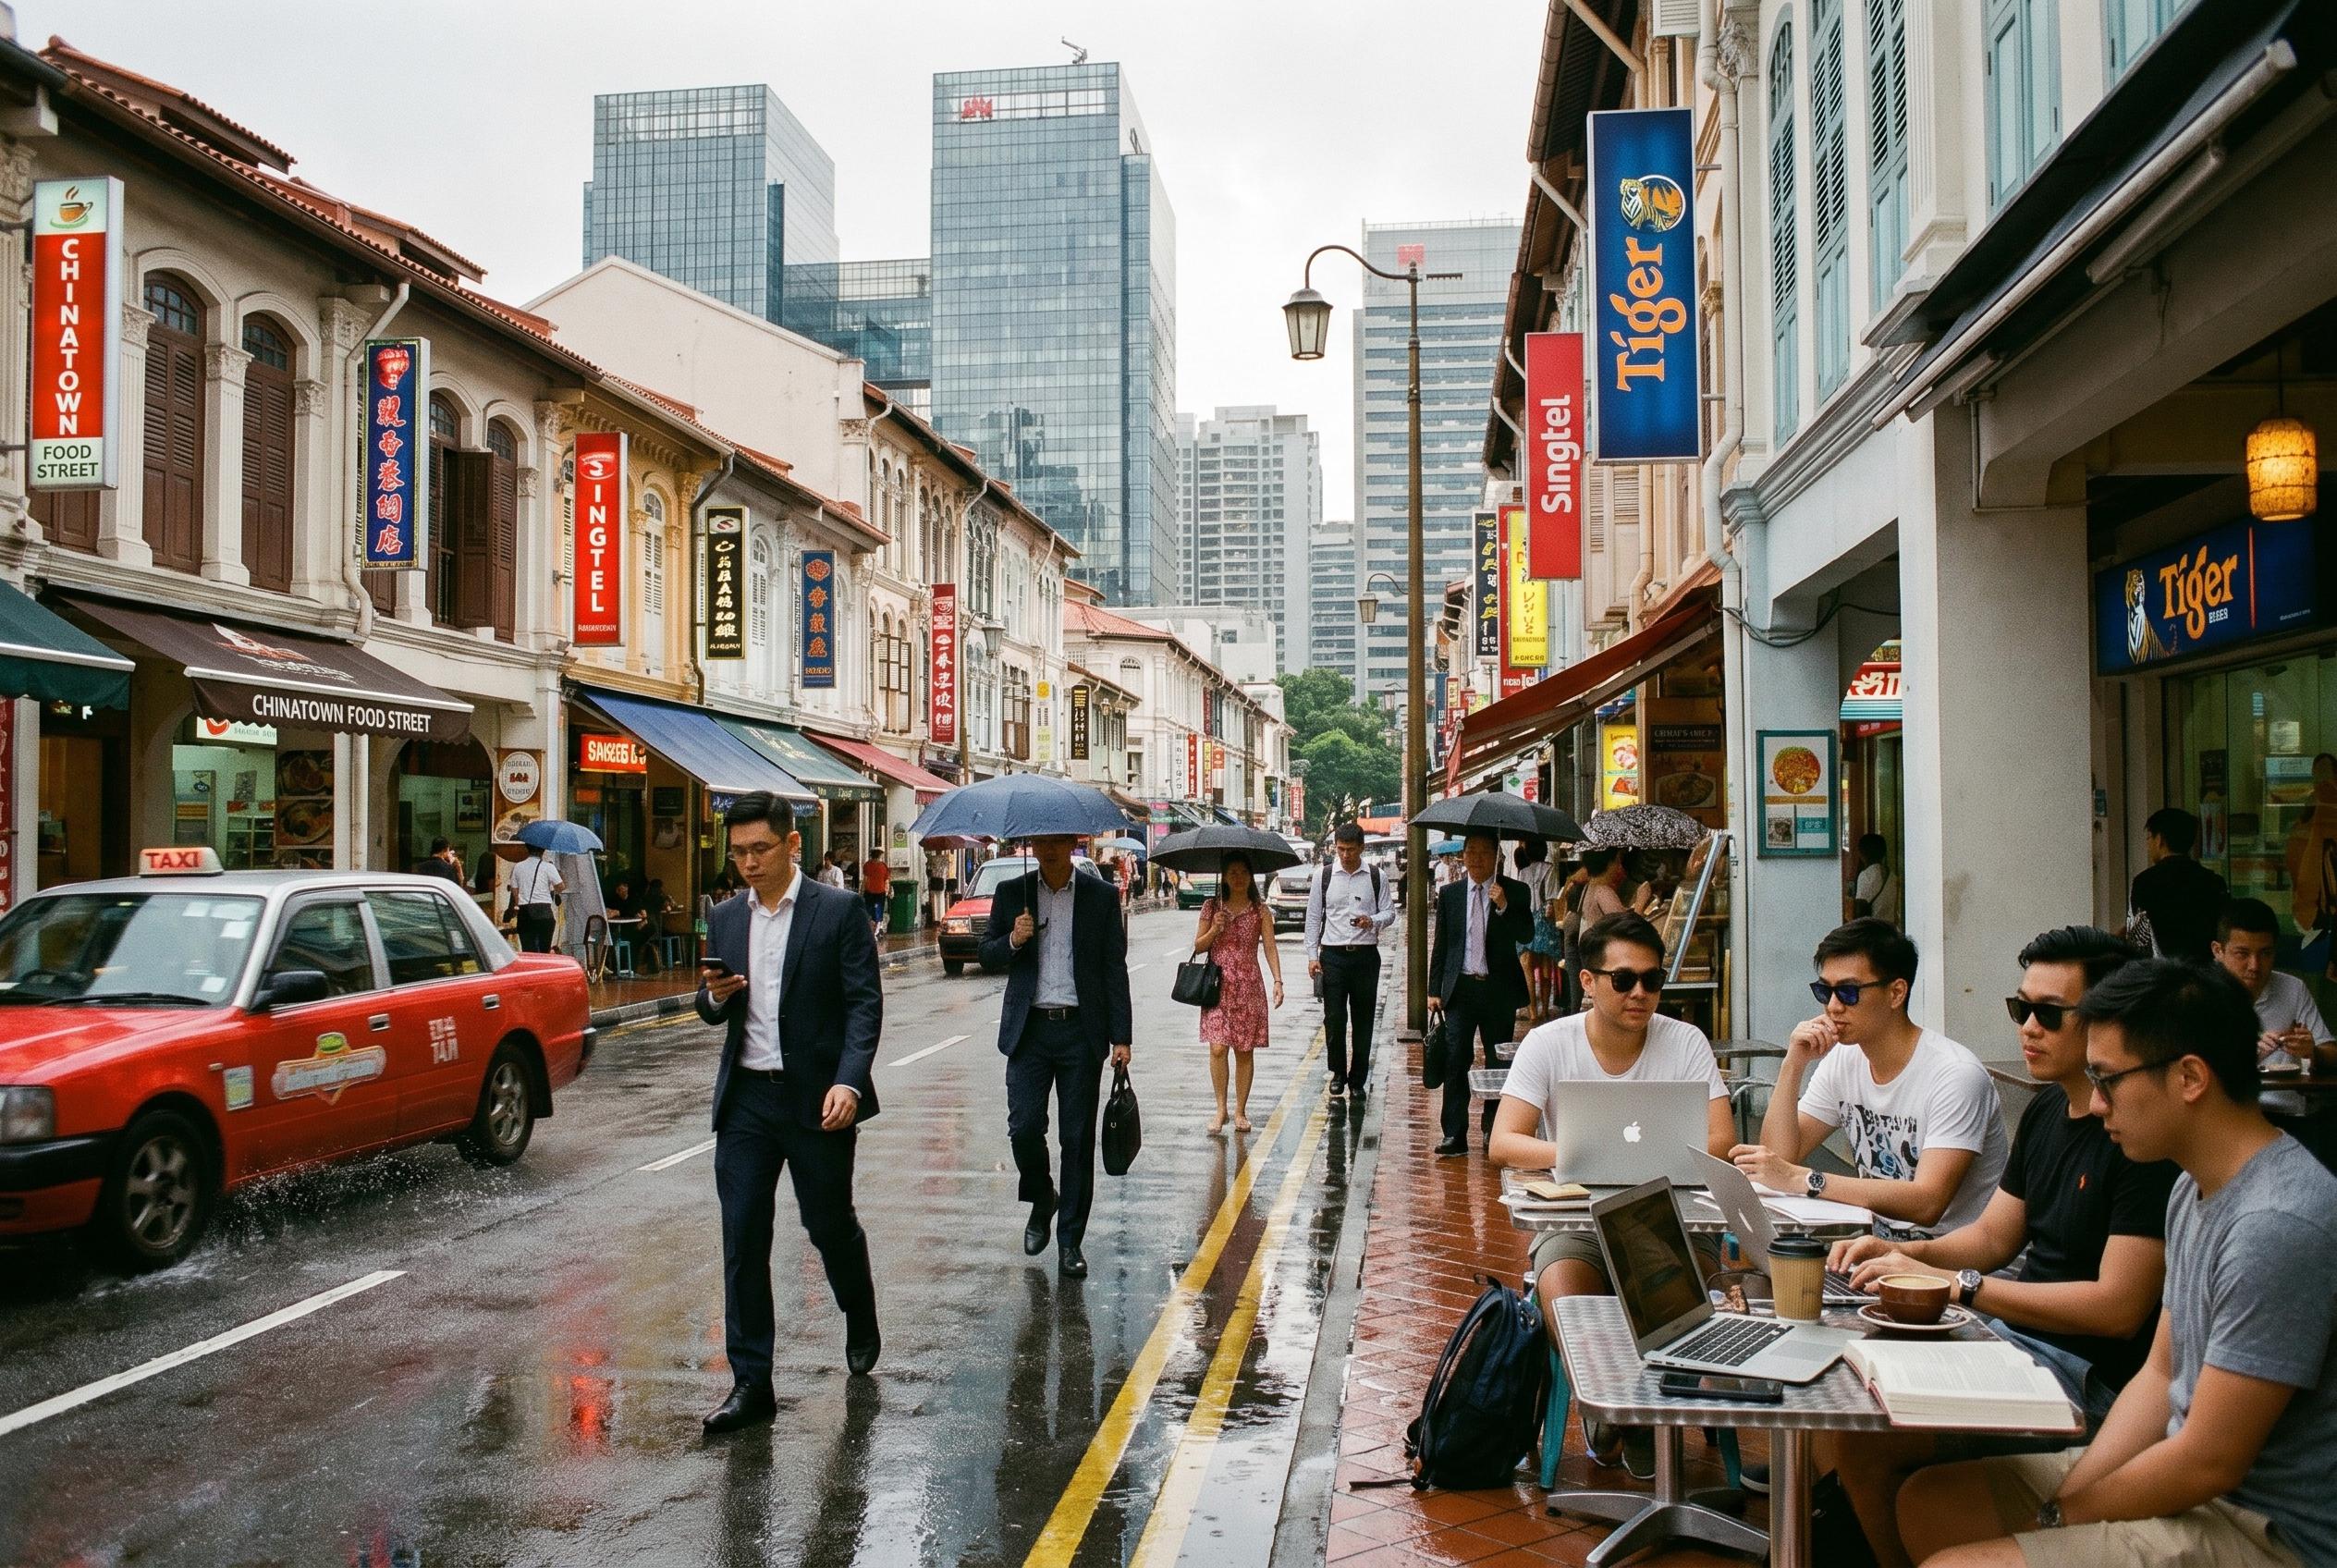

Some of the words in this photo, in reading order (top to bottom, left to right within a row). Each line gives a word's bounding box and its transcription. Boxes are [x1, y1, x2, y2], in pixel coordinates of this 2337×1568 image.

[55, 239, 81, 435] CHINATOWN
[1609, 237, 1687, 392] Tiger
[37, 462, 99, 478] STREET
[43, 445, 92, 460] FOOD
[1539, 395, 1581, 513] Singtel
[2159, 545, 2238, 640] Tiger
[252, 693, 344, 724] CHINATOWN
[348, 704, 385, 729] FOOD
[388, 710, 431, 733] STREET
[145, 851, 199, 869] TAXI
